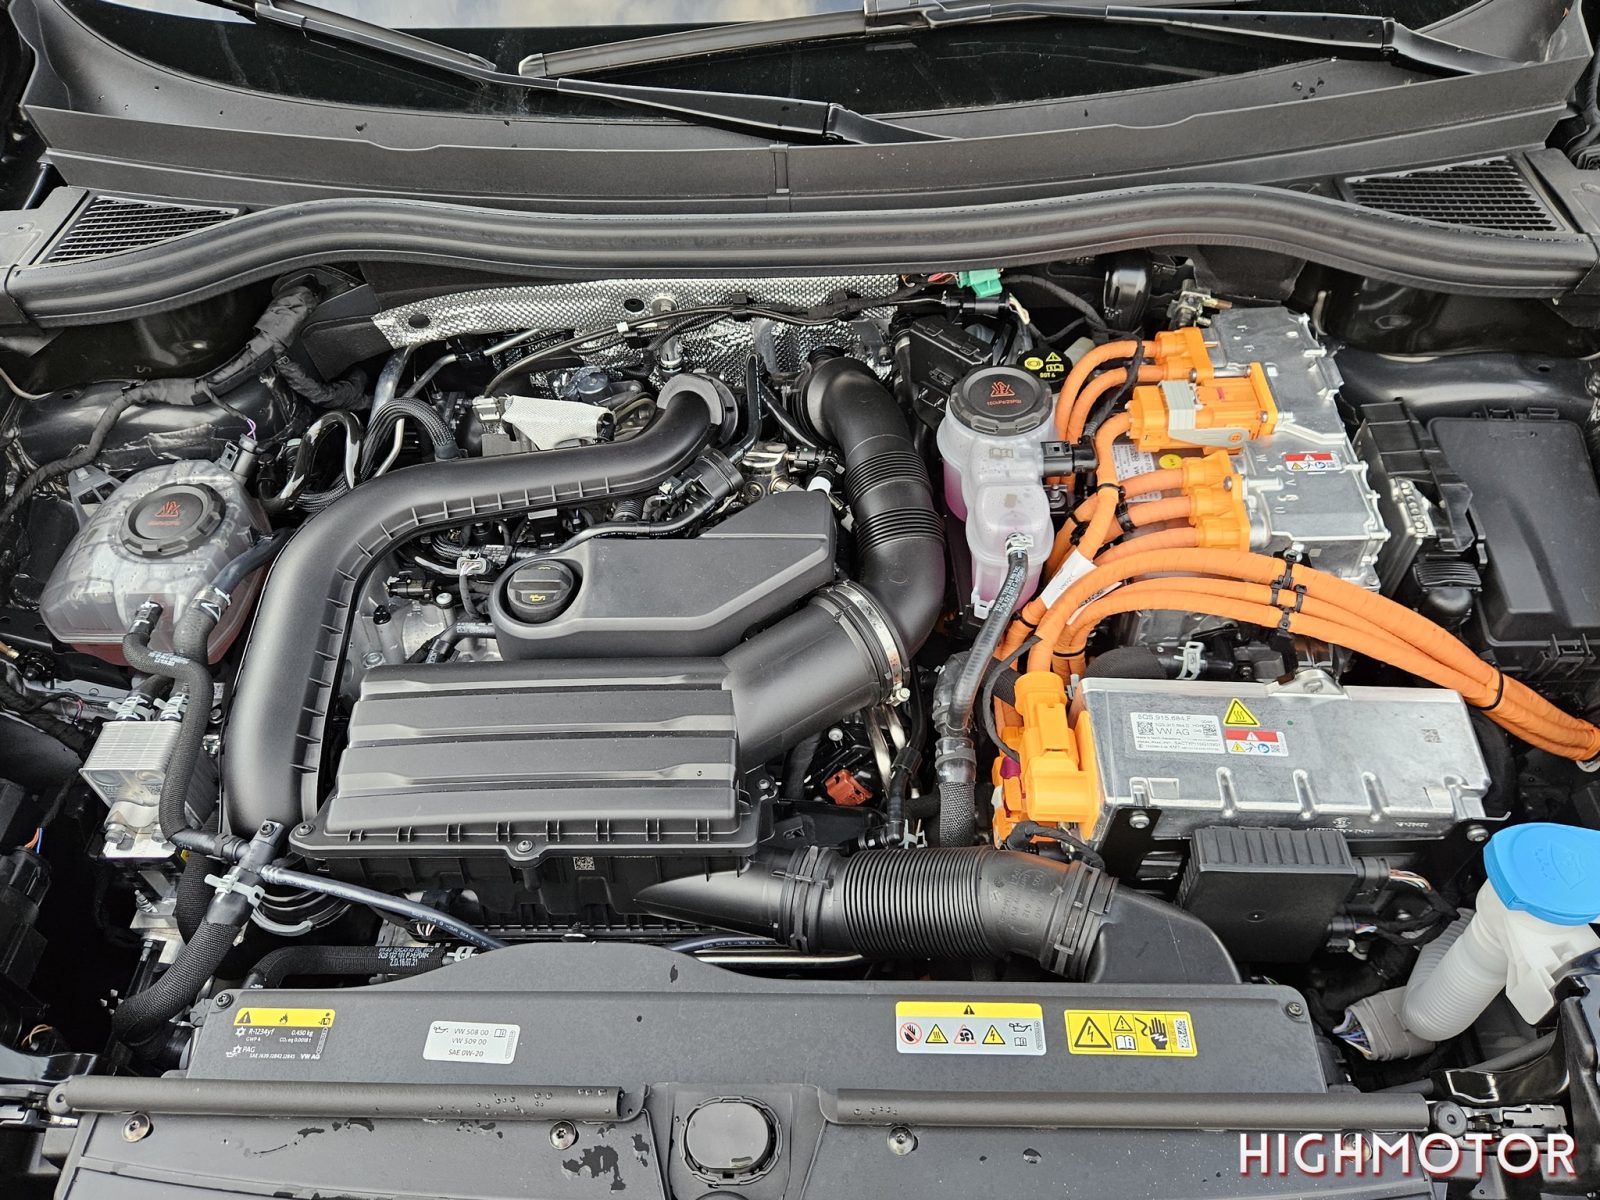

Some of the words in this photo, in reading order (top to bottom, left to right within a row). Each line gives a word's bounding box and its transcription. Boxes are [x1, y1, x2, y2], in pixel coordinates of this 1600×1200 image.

[1156, 727, 1172, 735] VW
[1176, 728, 1190, 736] AG
[248, 1028, 275, 1037] R-1234yf
[448, 1048, 460, 1056] SAE
